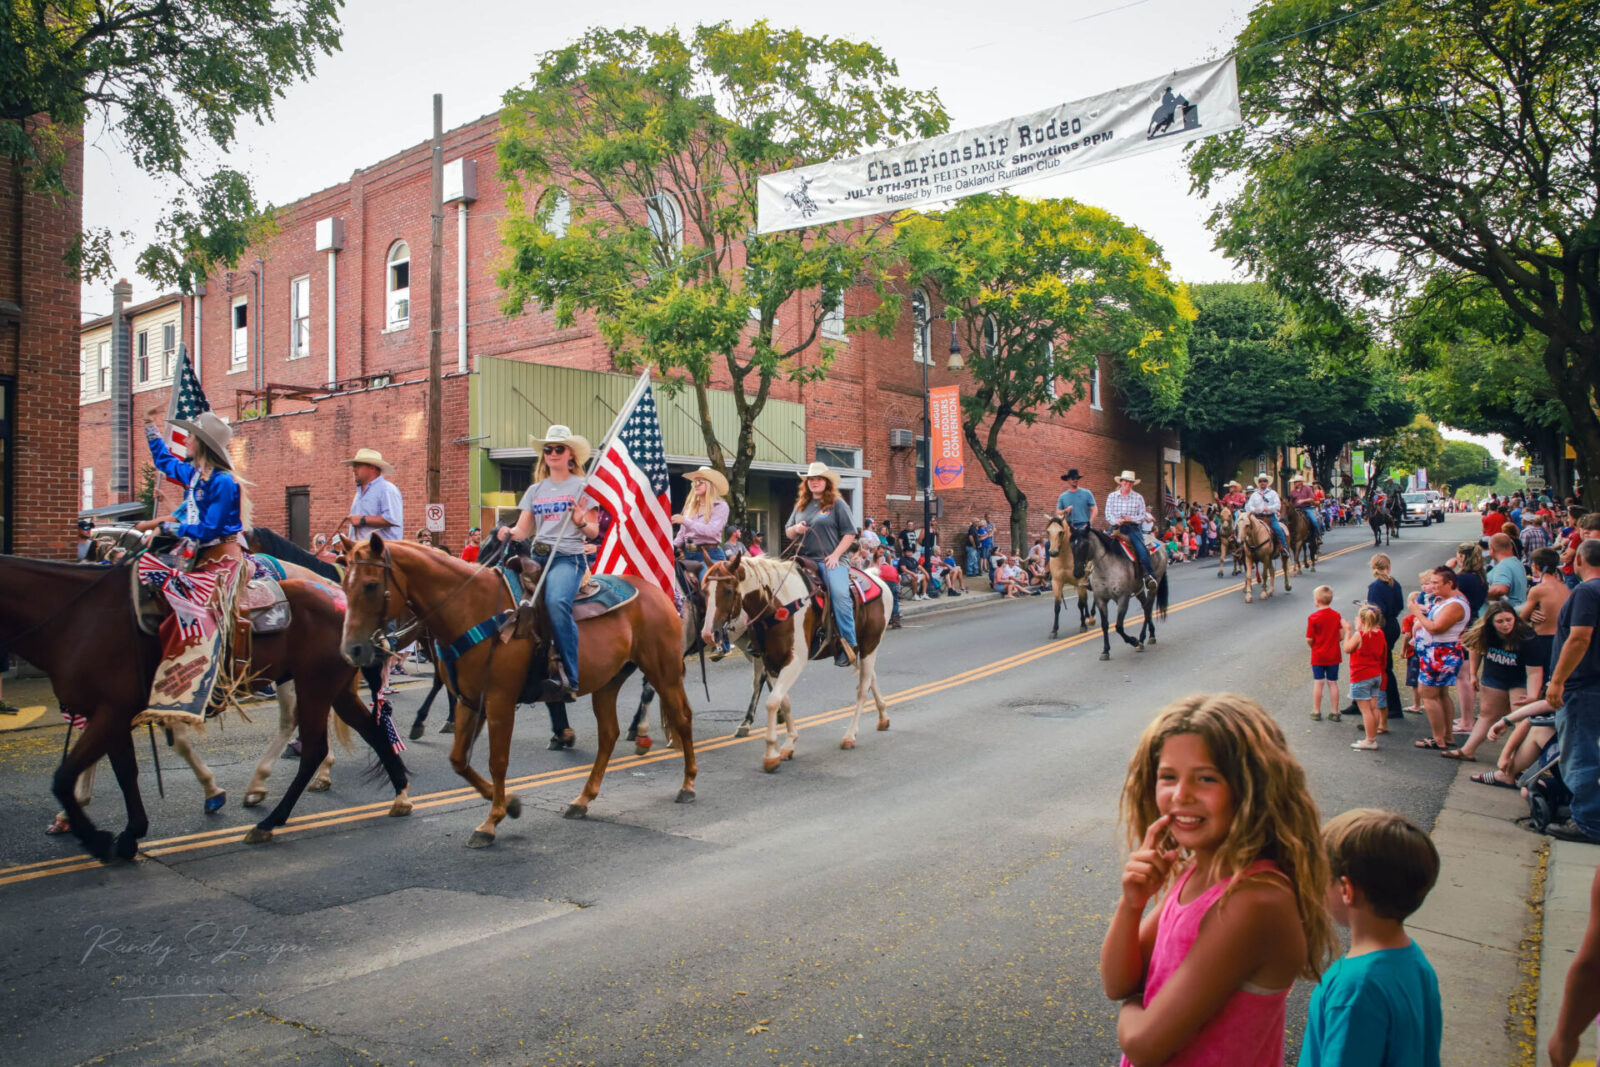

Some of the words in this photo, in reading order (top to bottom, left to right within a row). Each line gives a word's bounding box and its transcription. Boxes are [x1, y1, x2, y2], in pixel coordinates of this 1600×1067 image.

[844, 186, 873, 200] JULY
[877, 176, 929, 195] 8TH-9TH
[933, 167, 968, 183] FELTS
[971, 159, 1006, 174] PARK
[1011, 142, 1079, 165] Showtime
[1083, 130, 1113, 147] 8PM
[867, 135, 1009, 182] Championship
[1018, 117, 1081, 148] Rodeo
[886, 190, 919, 203] Hosted
[921, 187, 932, 200] by
[935, 184, 953, 195] The
[955, 173, 995, 190] Oakland
[998, 165, 1033, 181] Ruritan
[1036, 158, 1060, 172] Club
[941, 398, 950, 438] FIDDLERS
[951, 398, 960, 458] CONVENTION
[942, 440, 950, 458] OLD
[1487, 652, 1517, 666] MAMA
